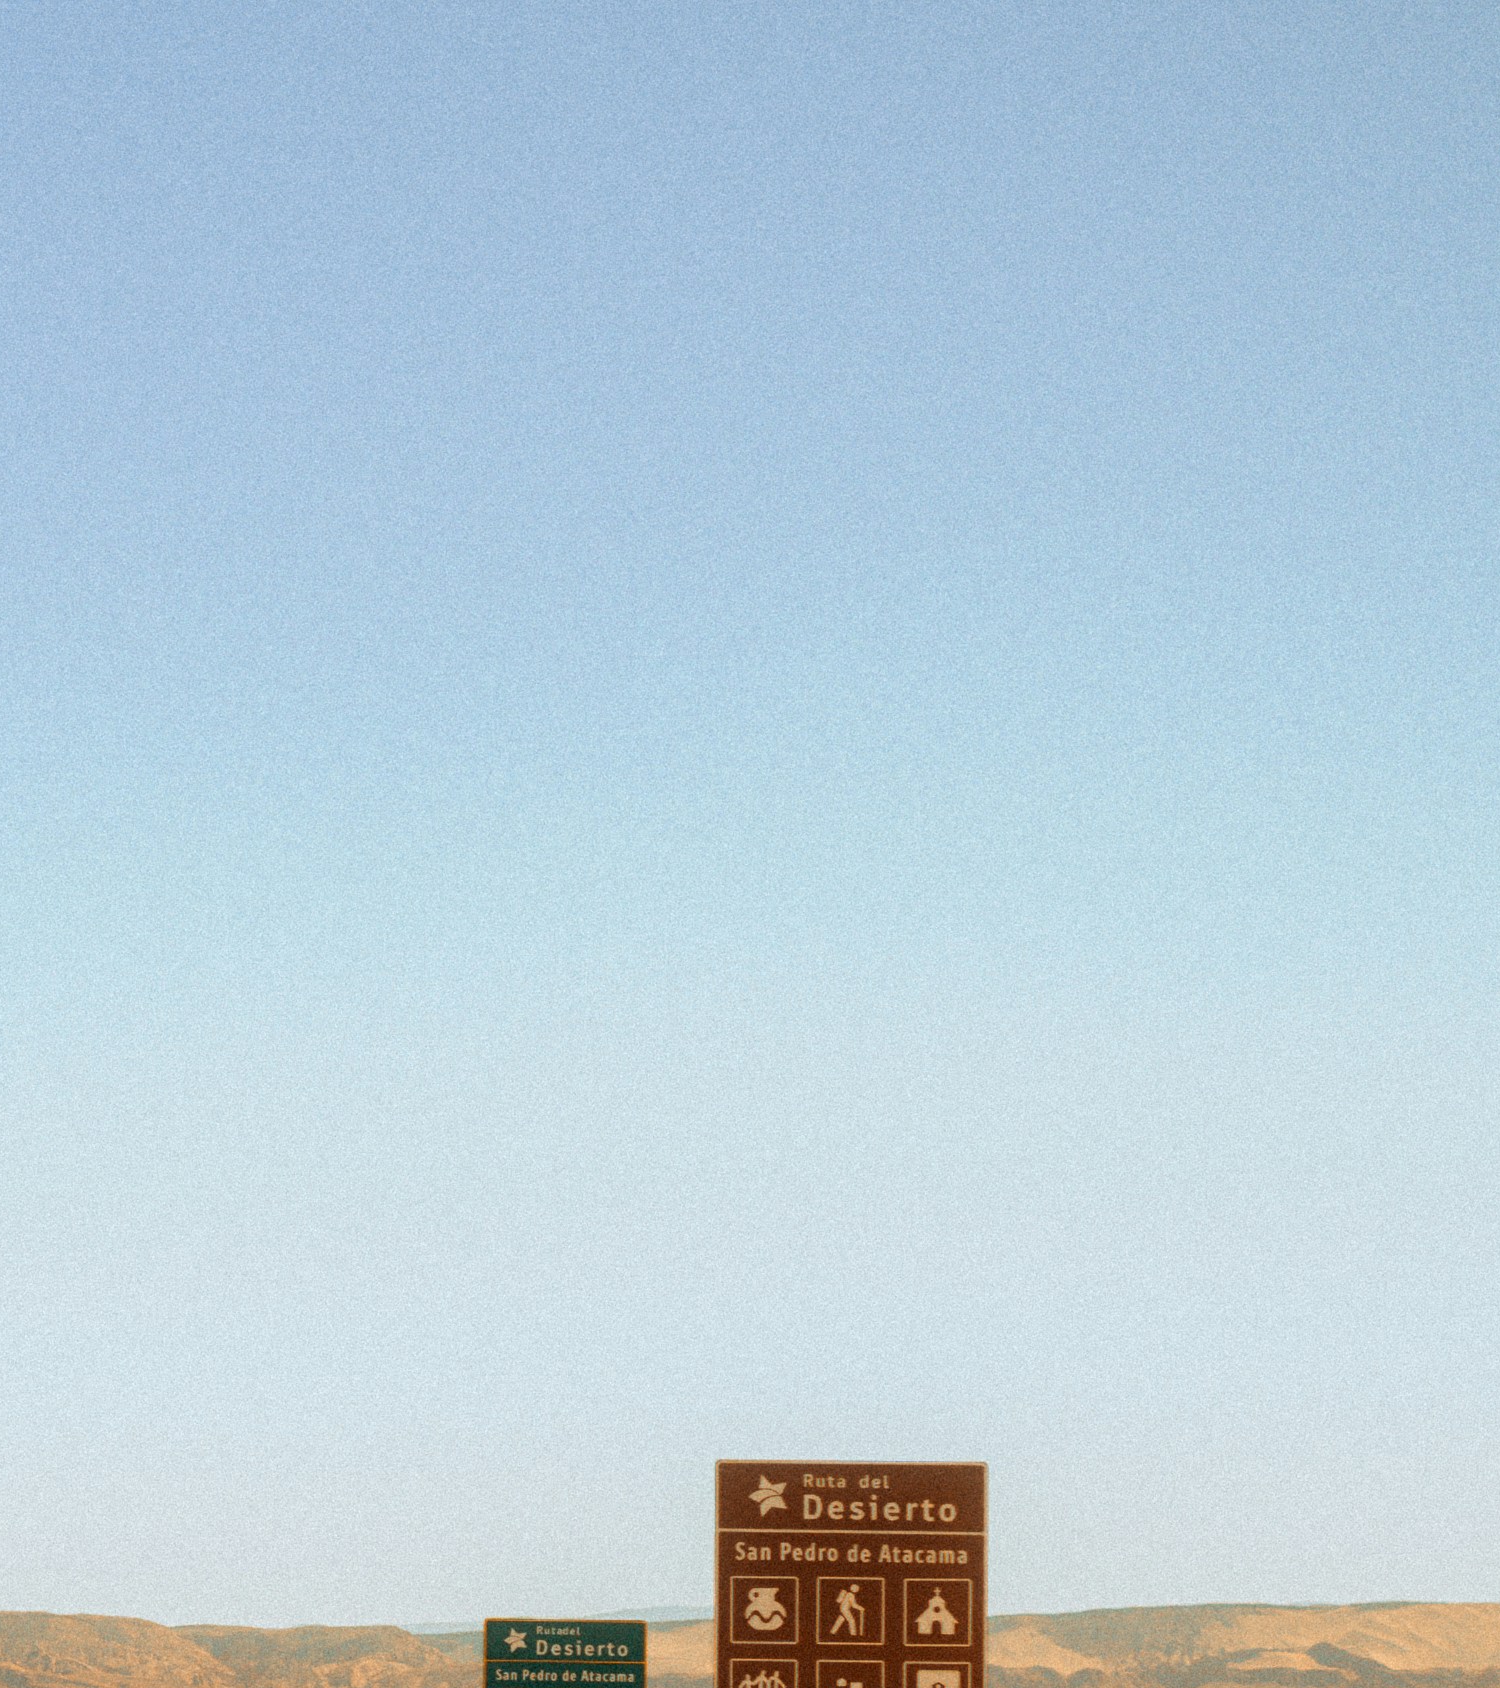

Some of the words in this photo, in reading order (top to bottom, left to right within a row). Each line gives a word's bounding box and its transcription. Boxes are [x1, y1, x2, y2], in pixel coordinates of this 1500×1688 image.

[803, 1474, 847, 1489] Ruta
[859, 1474, 890, 1489] del
[803, 1494, 957, 1522] Desierto
[735, 1542, 771, 1561] San
[780, 1542, 839, 1562] Pedro
[847, 1543, 871, 1563] de
[878, 1544, 968, 1564] Atacama
[536, 1639, 629, 1656] Desierto
[495, 1669, 518, 1681] San
[522, 1669, 558, 1682] Pedro
[562, 1670, 576, 1682] de
[581, 1670, 635, 1682] Atacama
